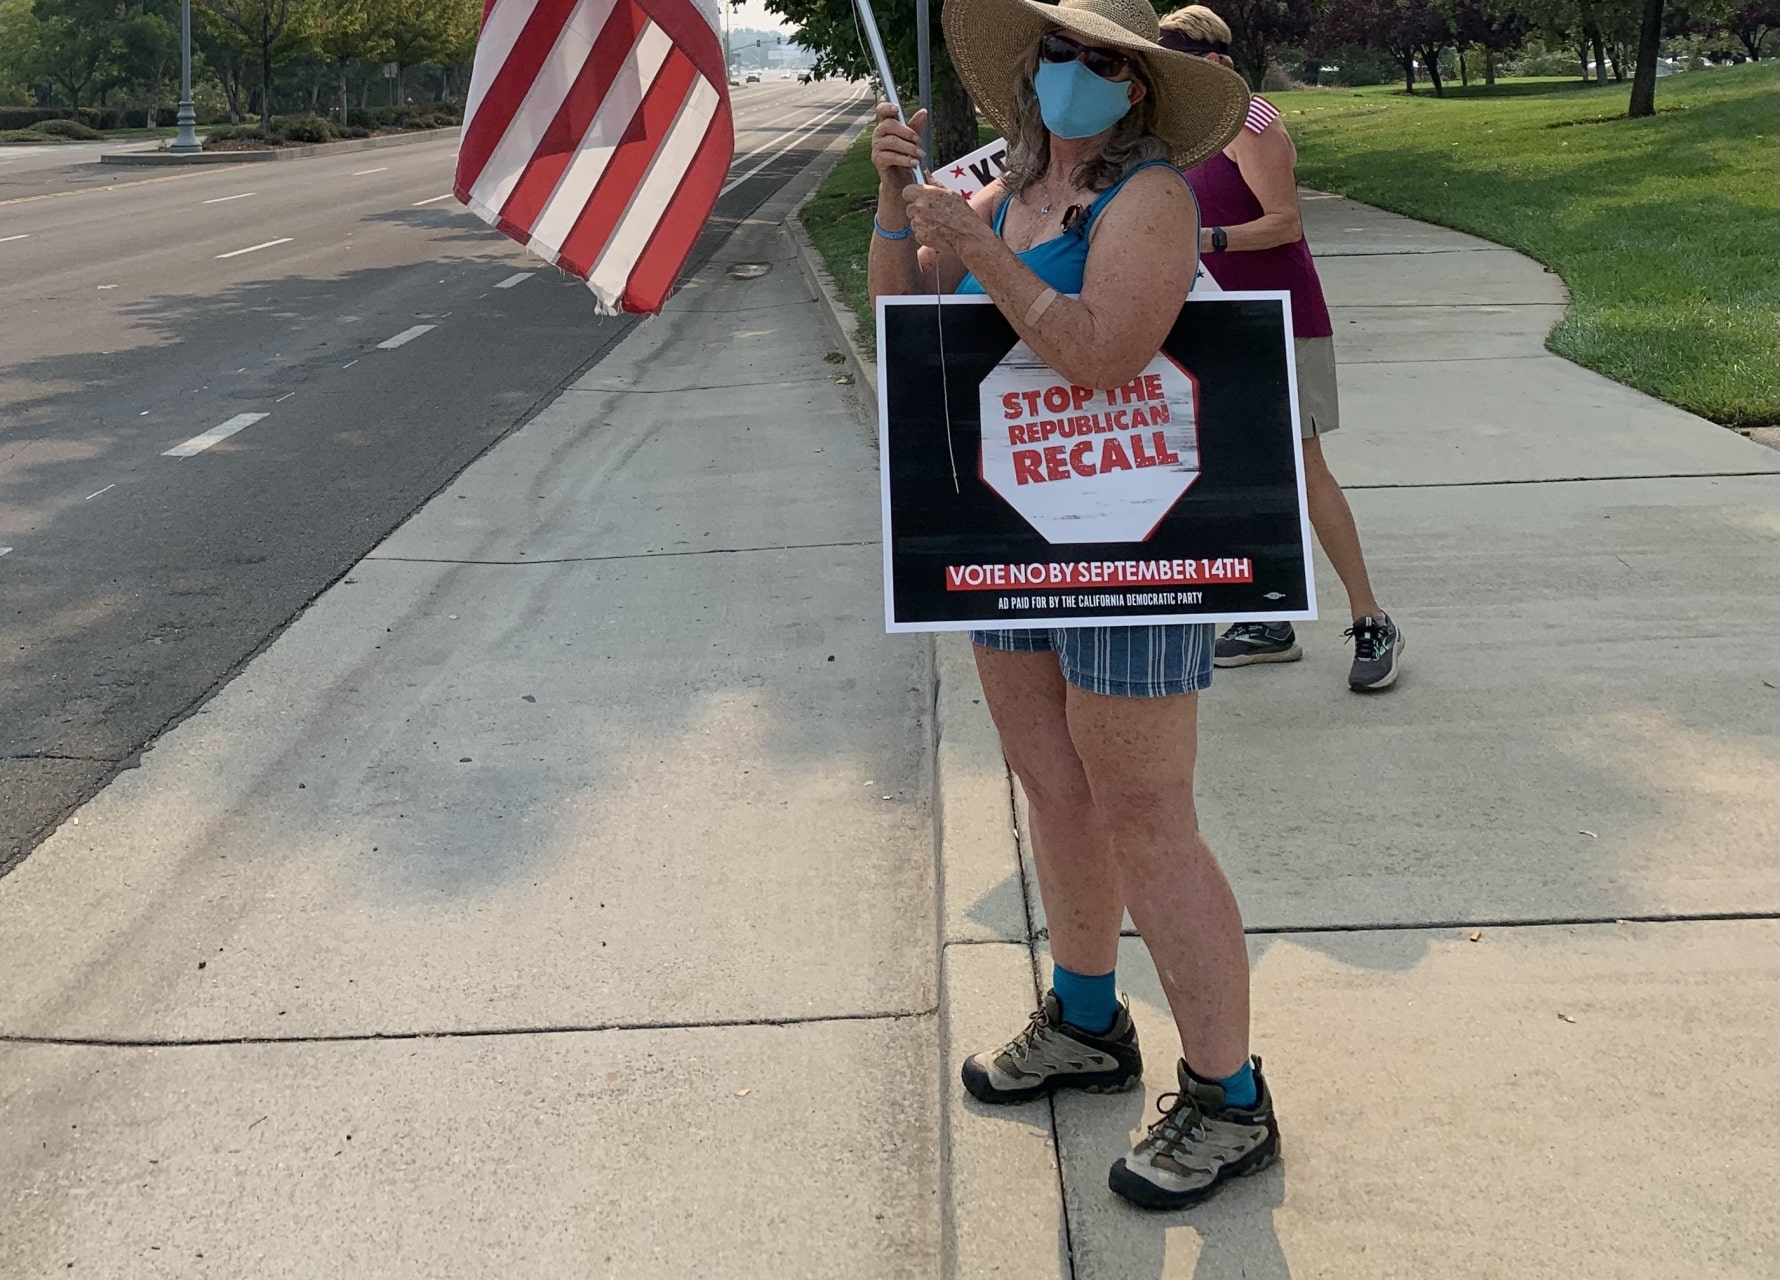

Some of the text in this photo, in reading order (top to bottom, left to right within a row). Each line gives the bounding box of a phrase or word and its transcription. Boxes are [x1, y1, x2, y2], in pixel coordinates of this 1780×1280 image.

[1002, 385, 1094, 419] STOP
[1008, 404, 1171, 445] REPUBLICAN
[1012, 431, 1179, 485] RECALL
[949, 558, 1249, 585] VOTE NO BY SEPTEMBER 14TH
[998, 591, 1203, 609] AD PAID FOR BY THE CALIFORNIA DEMOCRATIC PARTY
